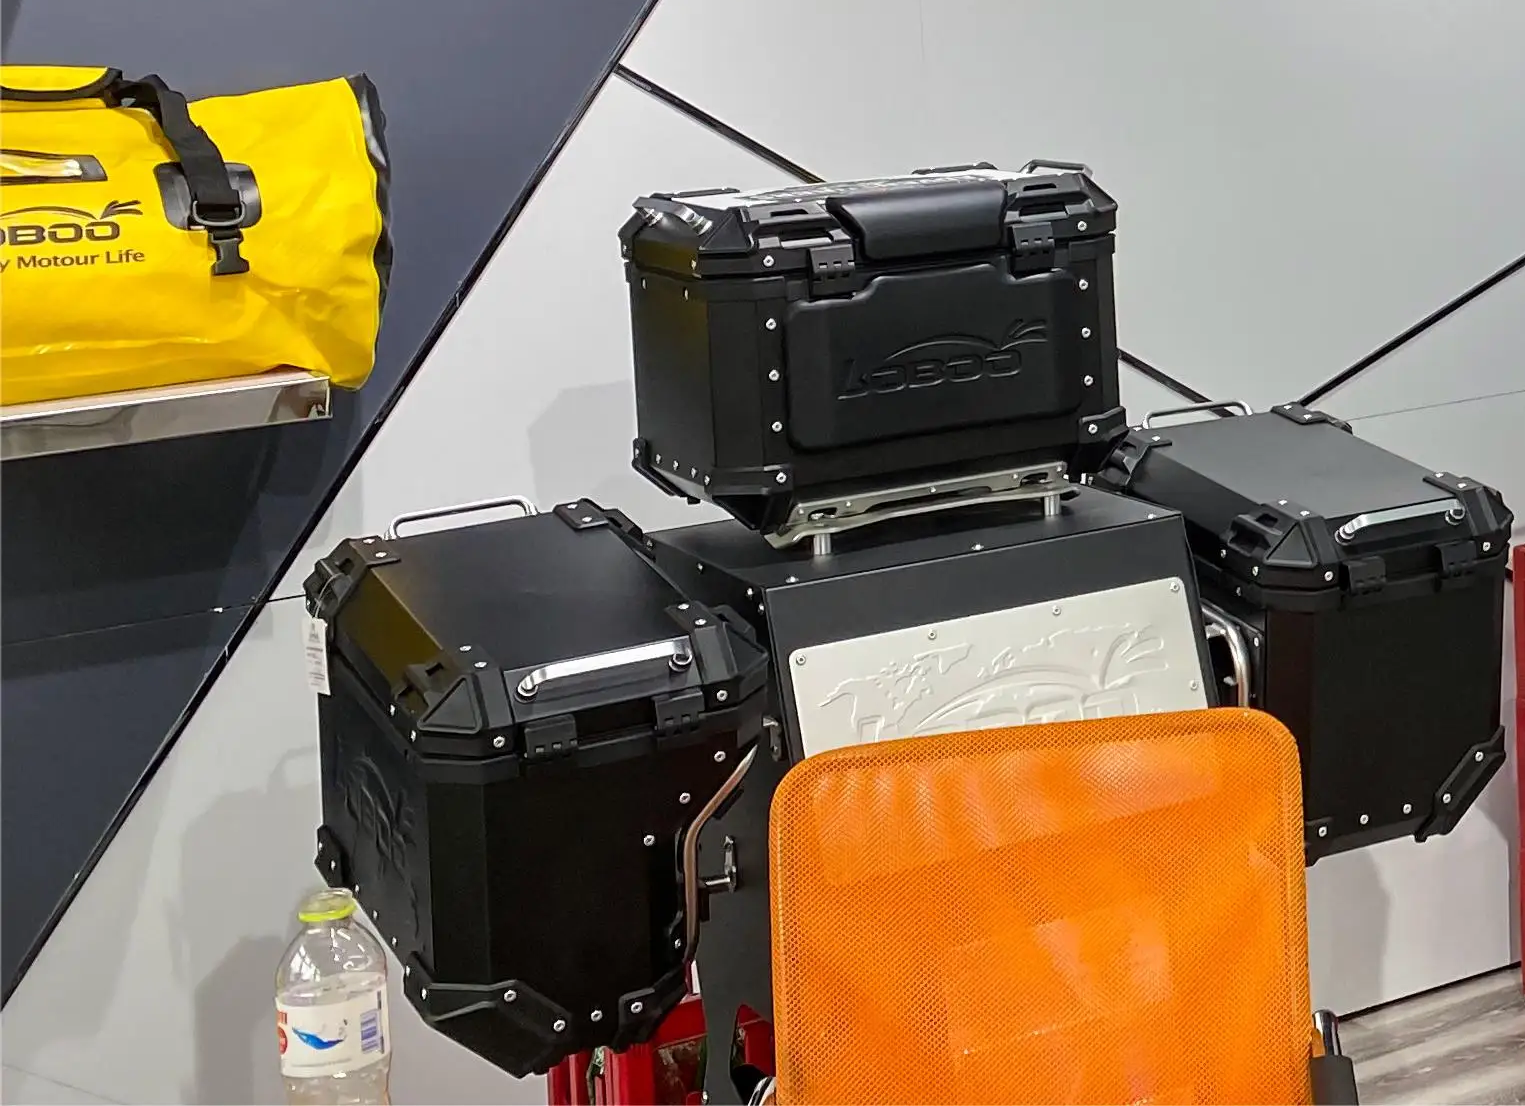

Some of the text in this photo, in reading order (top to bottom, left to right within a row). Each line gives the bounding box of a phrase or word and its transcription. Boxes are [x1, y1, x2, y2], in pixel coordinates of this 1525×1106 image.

[0, 221, 120, 246] BOO
[17, 253, 100, 270] Motour
[105, 249, 145, 265] Life
[837, 349, 1023, 400] LOBOO
